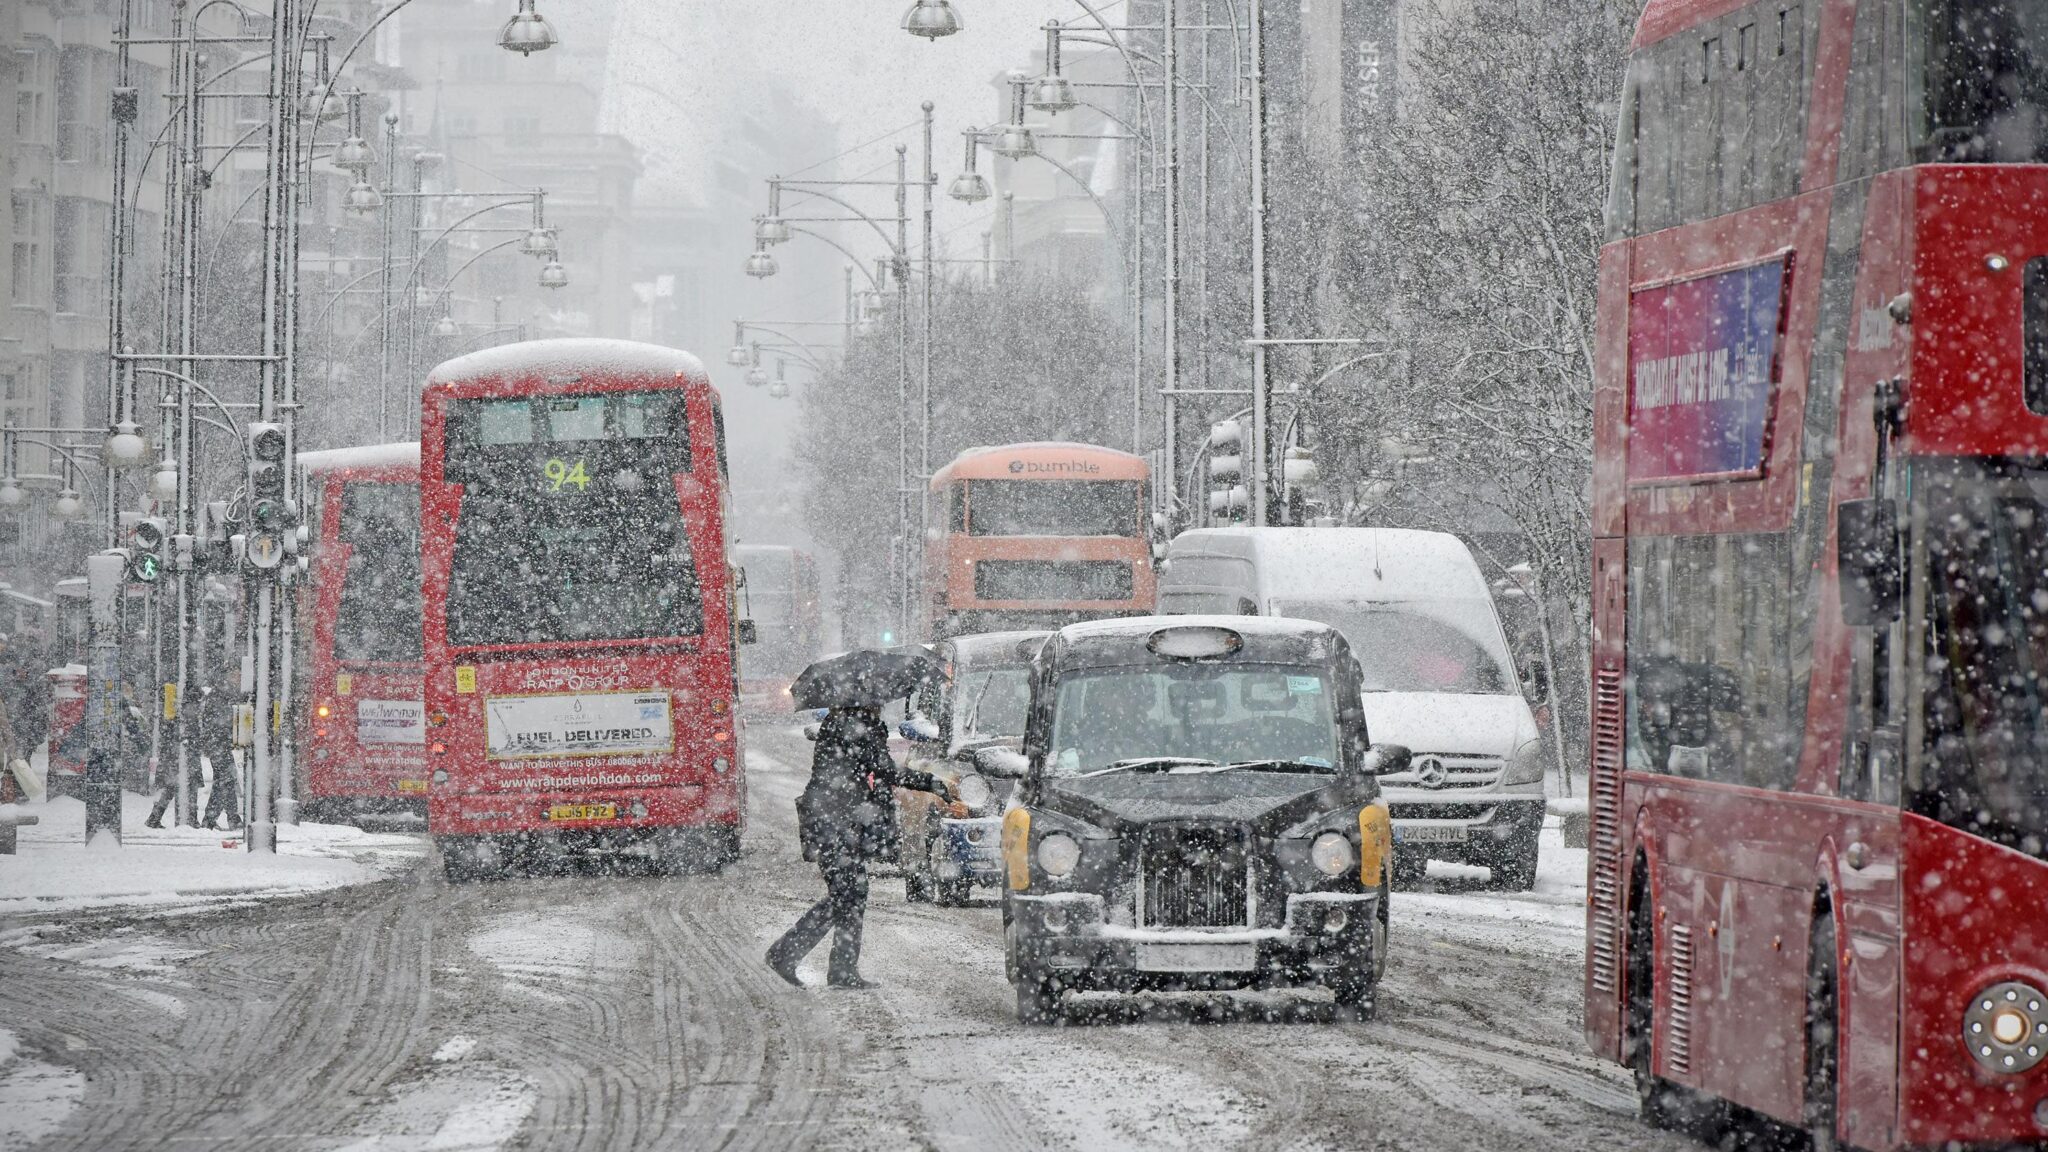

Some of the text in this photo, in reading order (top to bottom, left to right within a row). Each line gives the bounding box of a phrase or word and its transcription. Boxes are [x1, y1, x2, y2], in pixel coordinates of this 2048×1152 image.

[1027, 459, 1100, 474] bumble
[544, 459, 590, 491] 94
[526, 664, 629, 677] LONDON UNITED
[527, 676, 629, 689] RATP GROUP
[517, 728, 656, 744] FUEL. DELIVERED.
[500, 761, 524, 770] WANT
[527, 761, 538, 769] TO
[540, 760, 564, 768] DRIVE
[585, 758, 606, 766] BUS?
[500, 773, 662, 788] www.ratpdevlondon.com
